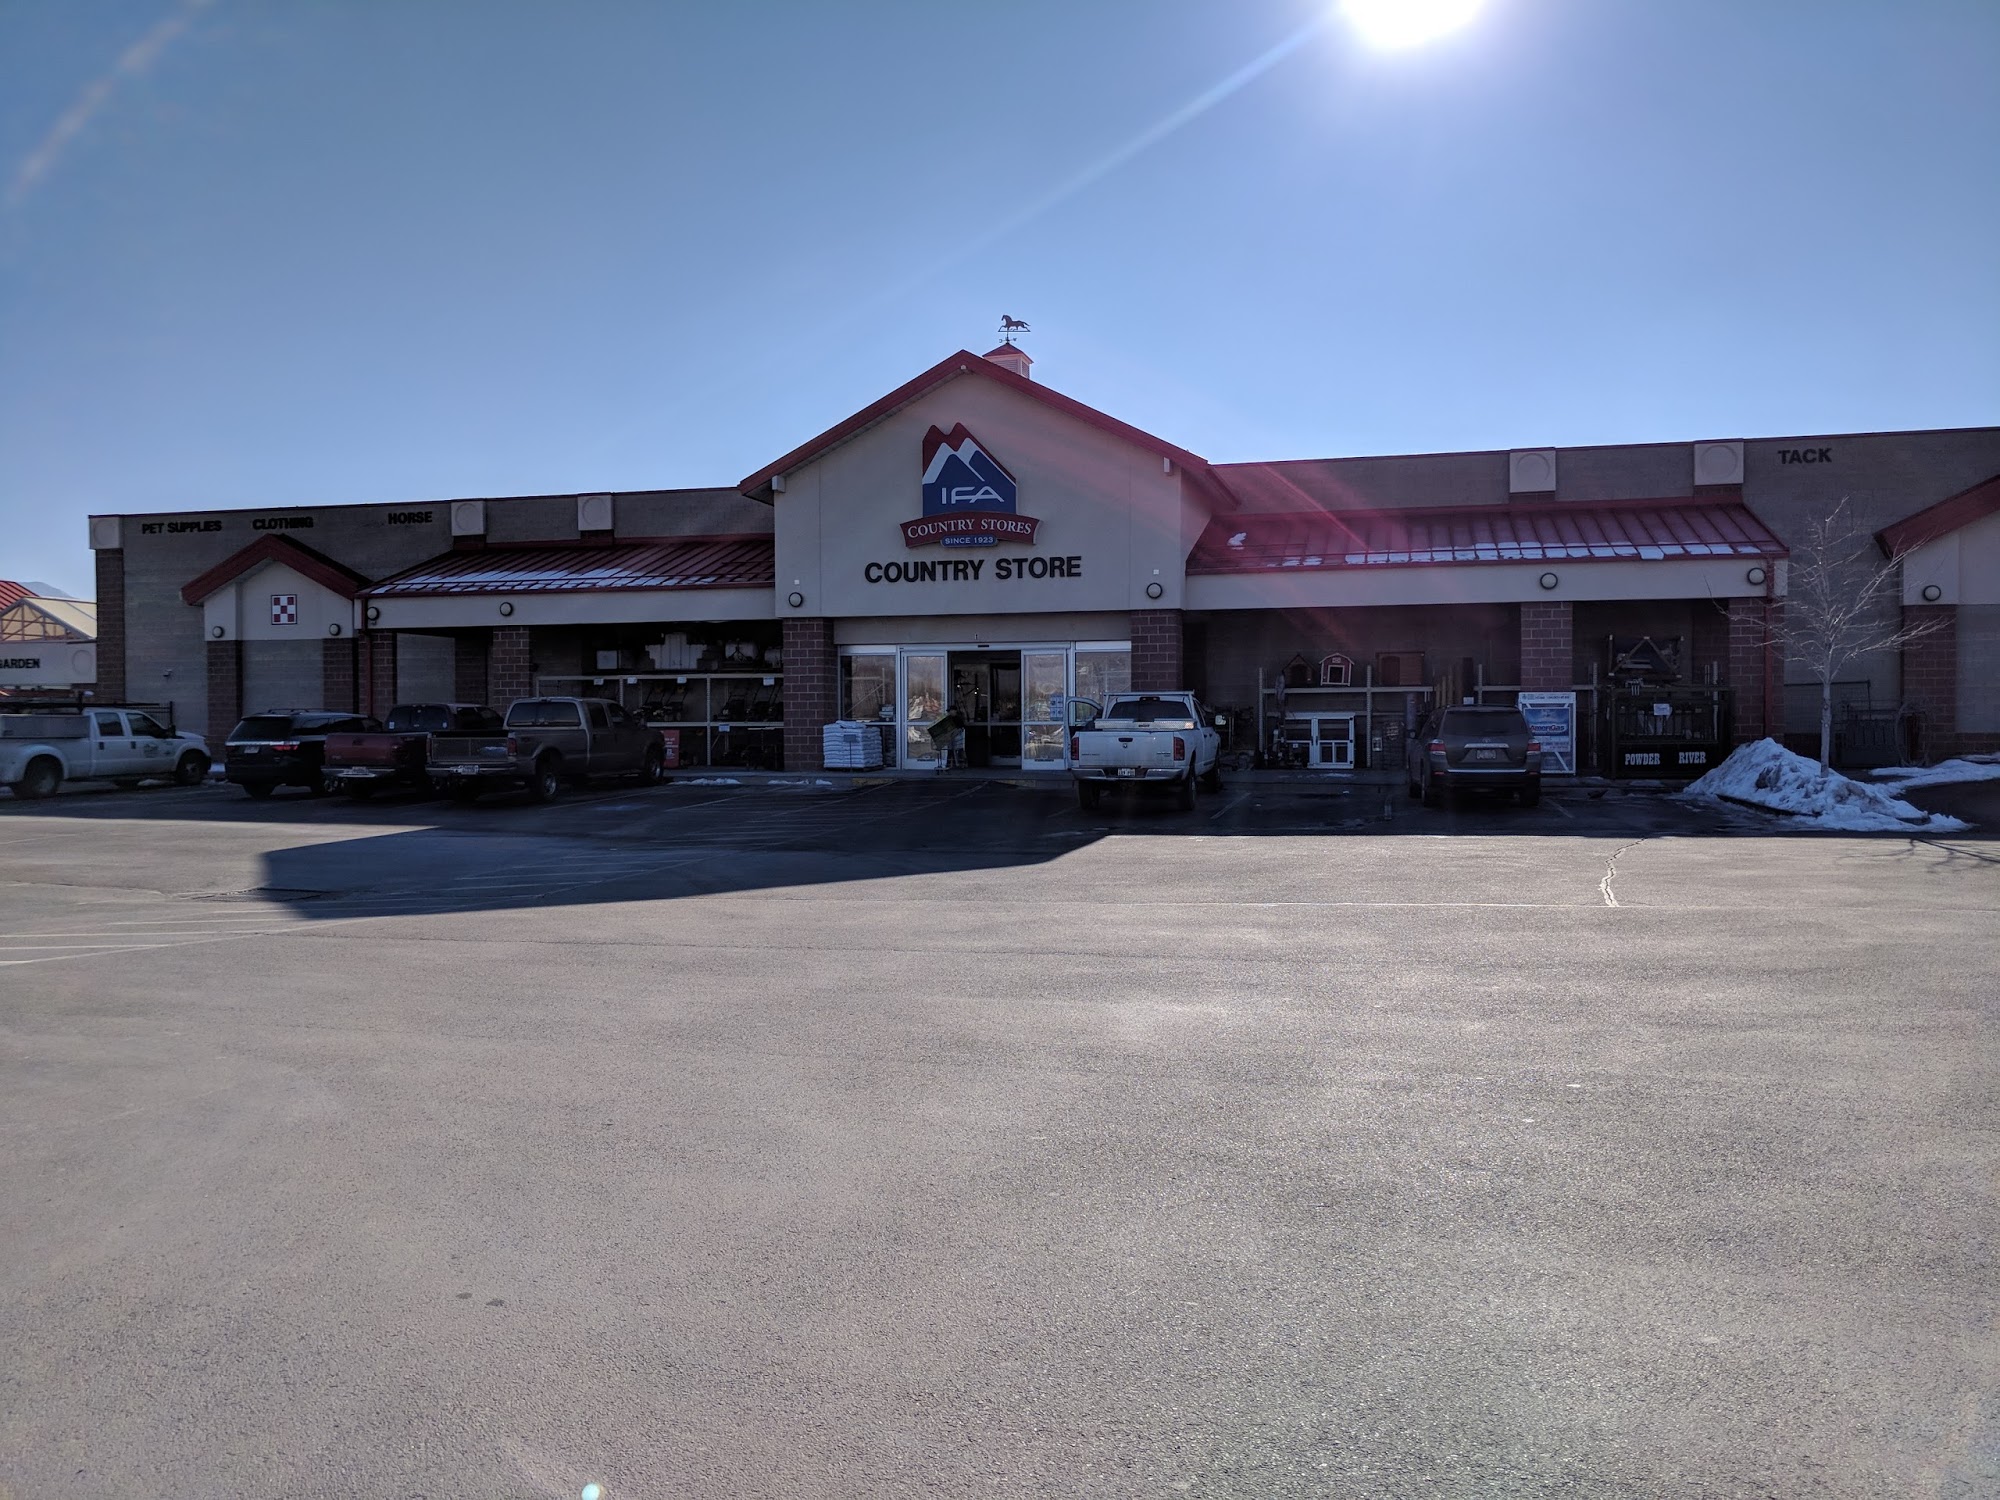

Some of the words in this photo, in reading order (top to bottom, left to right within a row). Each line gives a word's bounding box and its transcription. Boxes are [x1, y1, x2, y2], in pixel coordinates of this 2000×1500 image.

[1777, 448, 1832, 465] TACK
[941, 486, 1005, 505] IFA
[253, 516, 314, 530] CLOTHING
[388, 510, 433, 525] HORSE
[142, 523, 164, 535] PET
[167, 520, 222, 534] SUPPLIES
[907, 518, 975, 539] COUNTRY
[980, 518, 1032, 535] STORES
[944, 536, 971, 545] SINCE
[973, 536, 994, 544] 1923
[864, 559, 985, 583] COUNTRY
[995, 556, 1082, 580] STORE
[1624, 752, 1662, 767] POWDER
[1678, 751, 1707, 765] RIVER
